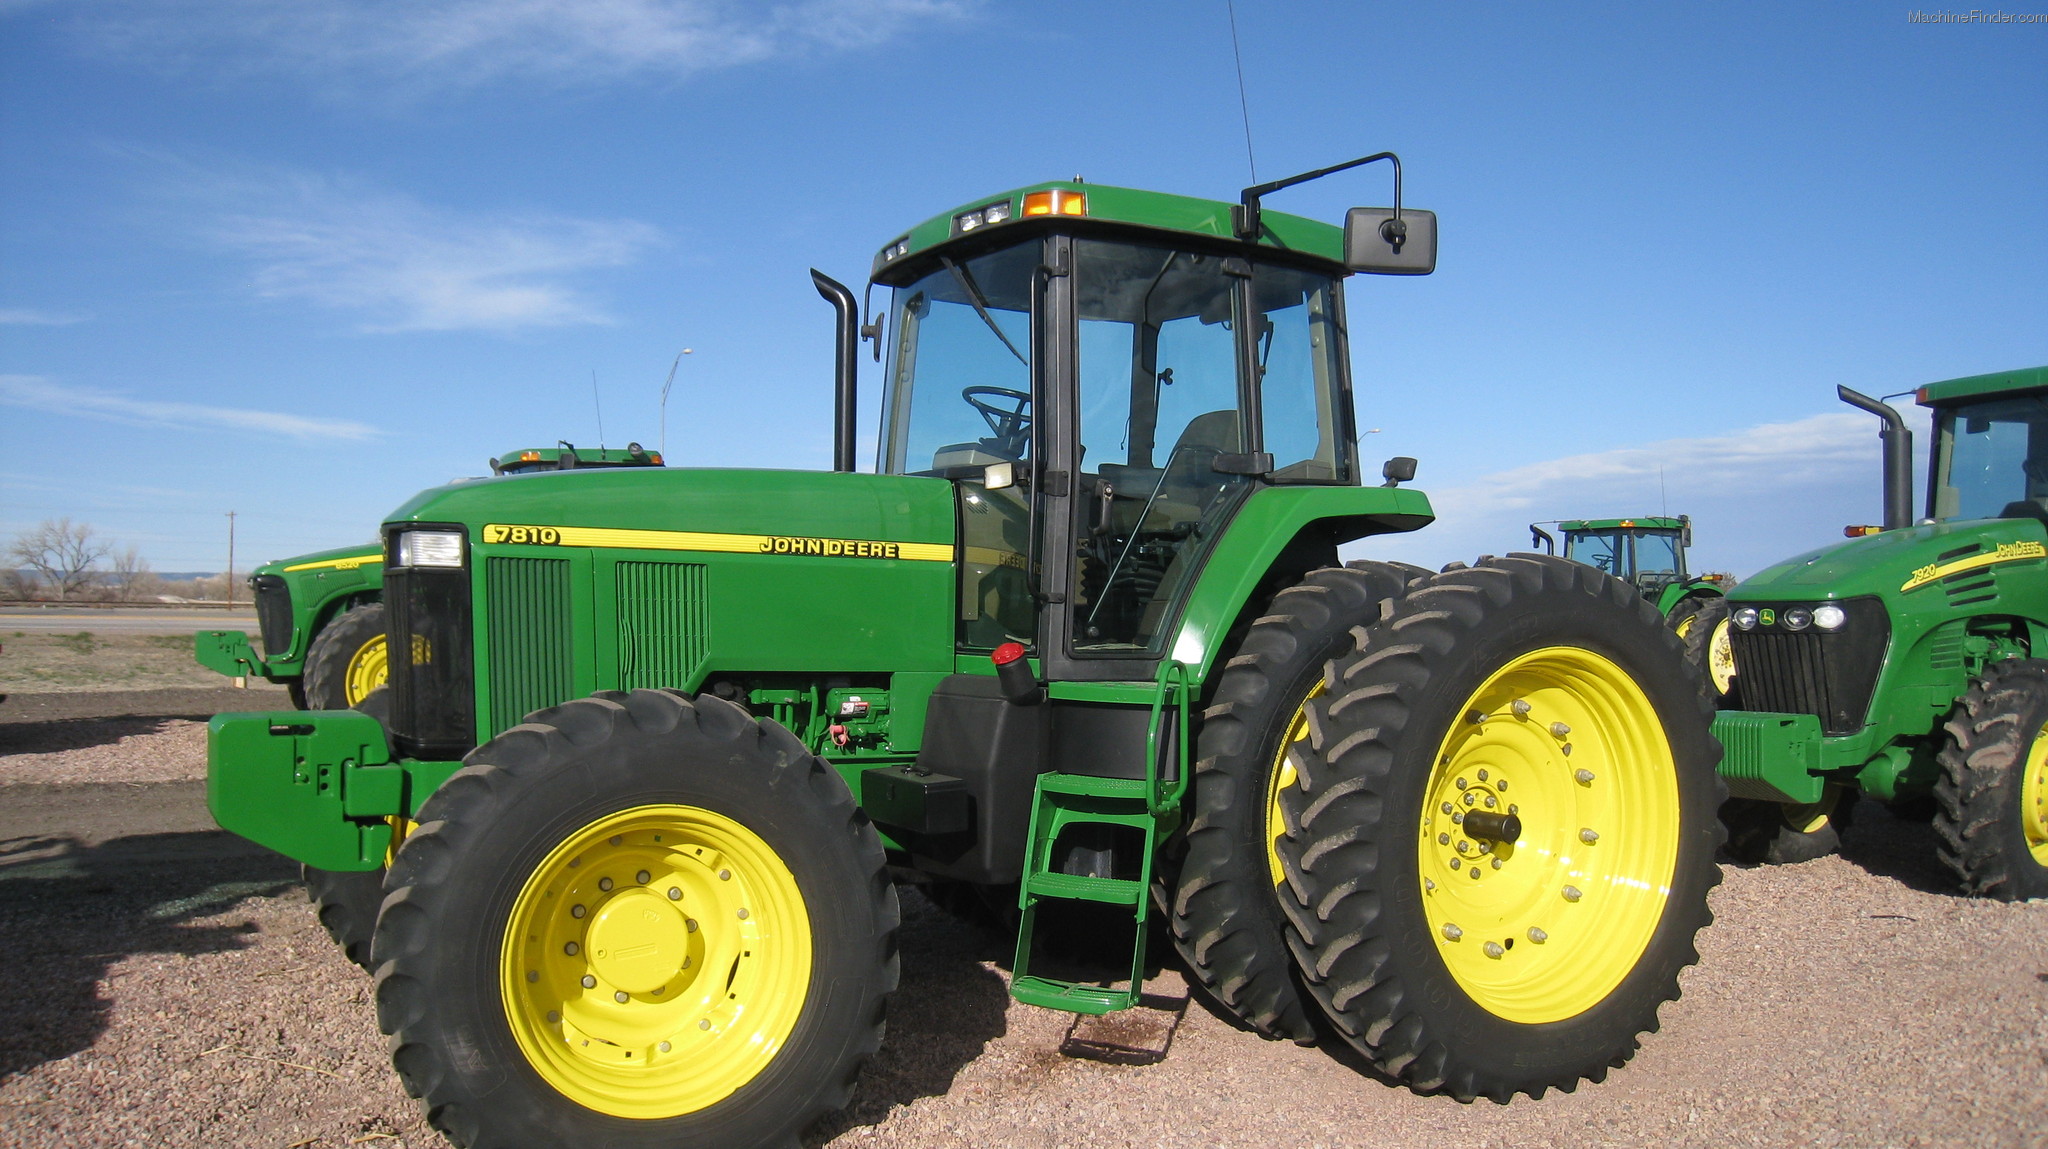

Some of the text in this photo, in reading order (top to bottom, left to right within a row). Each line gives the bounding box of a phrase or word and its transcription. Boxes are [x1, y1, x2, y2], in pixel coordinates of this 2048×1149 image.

[494, 526, 561, 545] 7810
[759, 537, 899, 559] JOHN DEERE
[1995, 541, 2042, 557] JOHN DEERE
[1911, 564, 1936, 583] 7920
